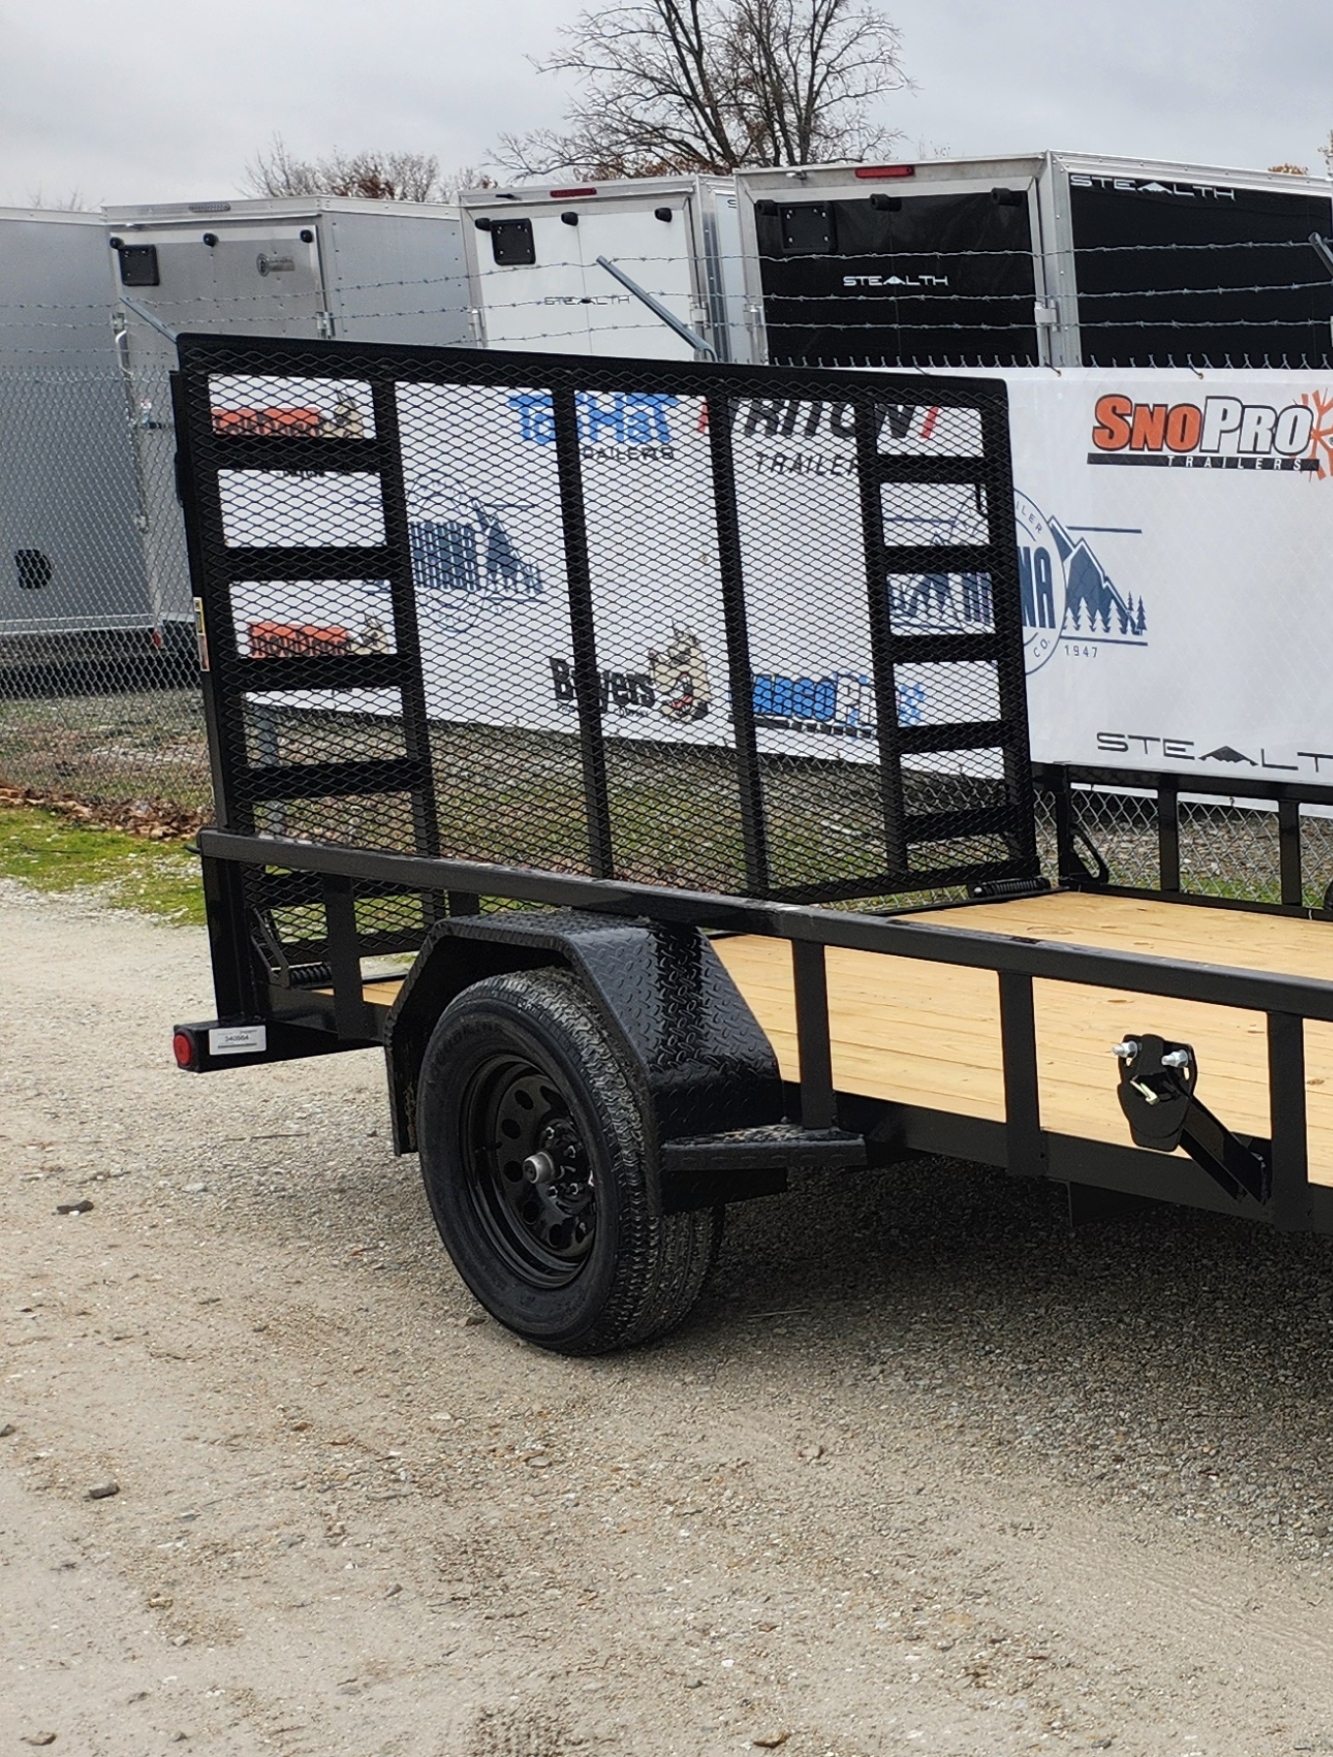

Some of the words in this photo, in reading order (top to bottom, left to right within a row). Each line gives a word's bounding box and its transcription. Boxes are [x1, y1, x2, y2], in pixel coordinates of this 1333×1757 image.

[1070, 174, 1235, 201] STEALTH
[843, 275, 949, 286] STEALTH
[1166, 455, 1303, 472] TRAILERS
[1064, 643, 1099, 659] 1947
